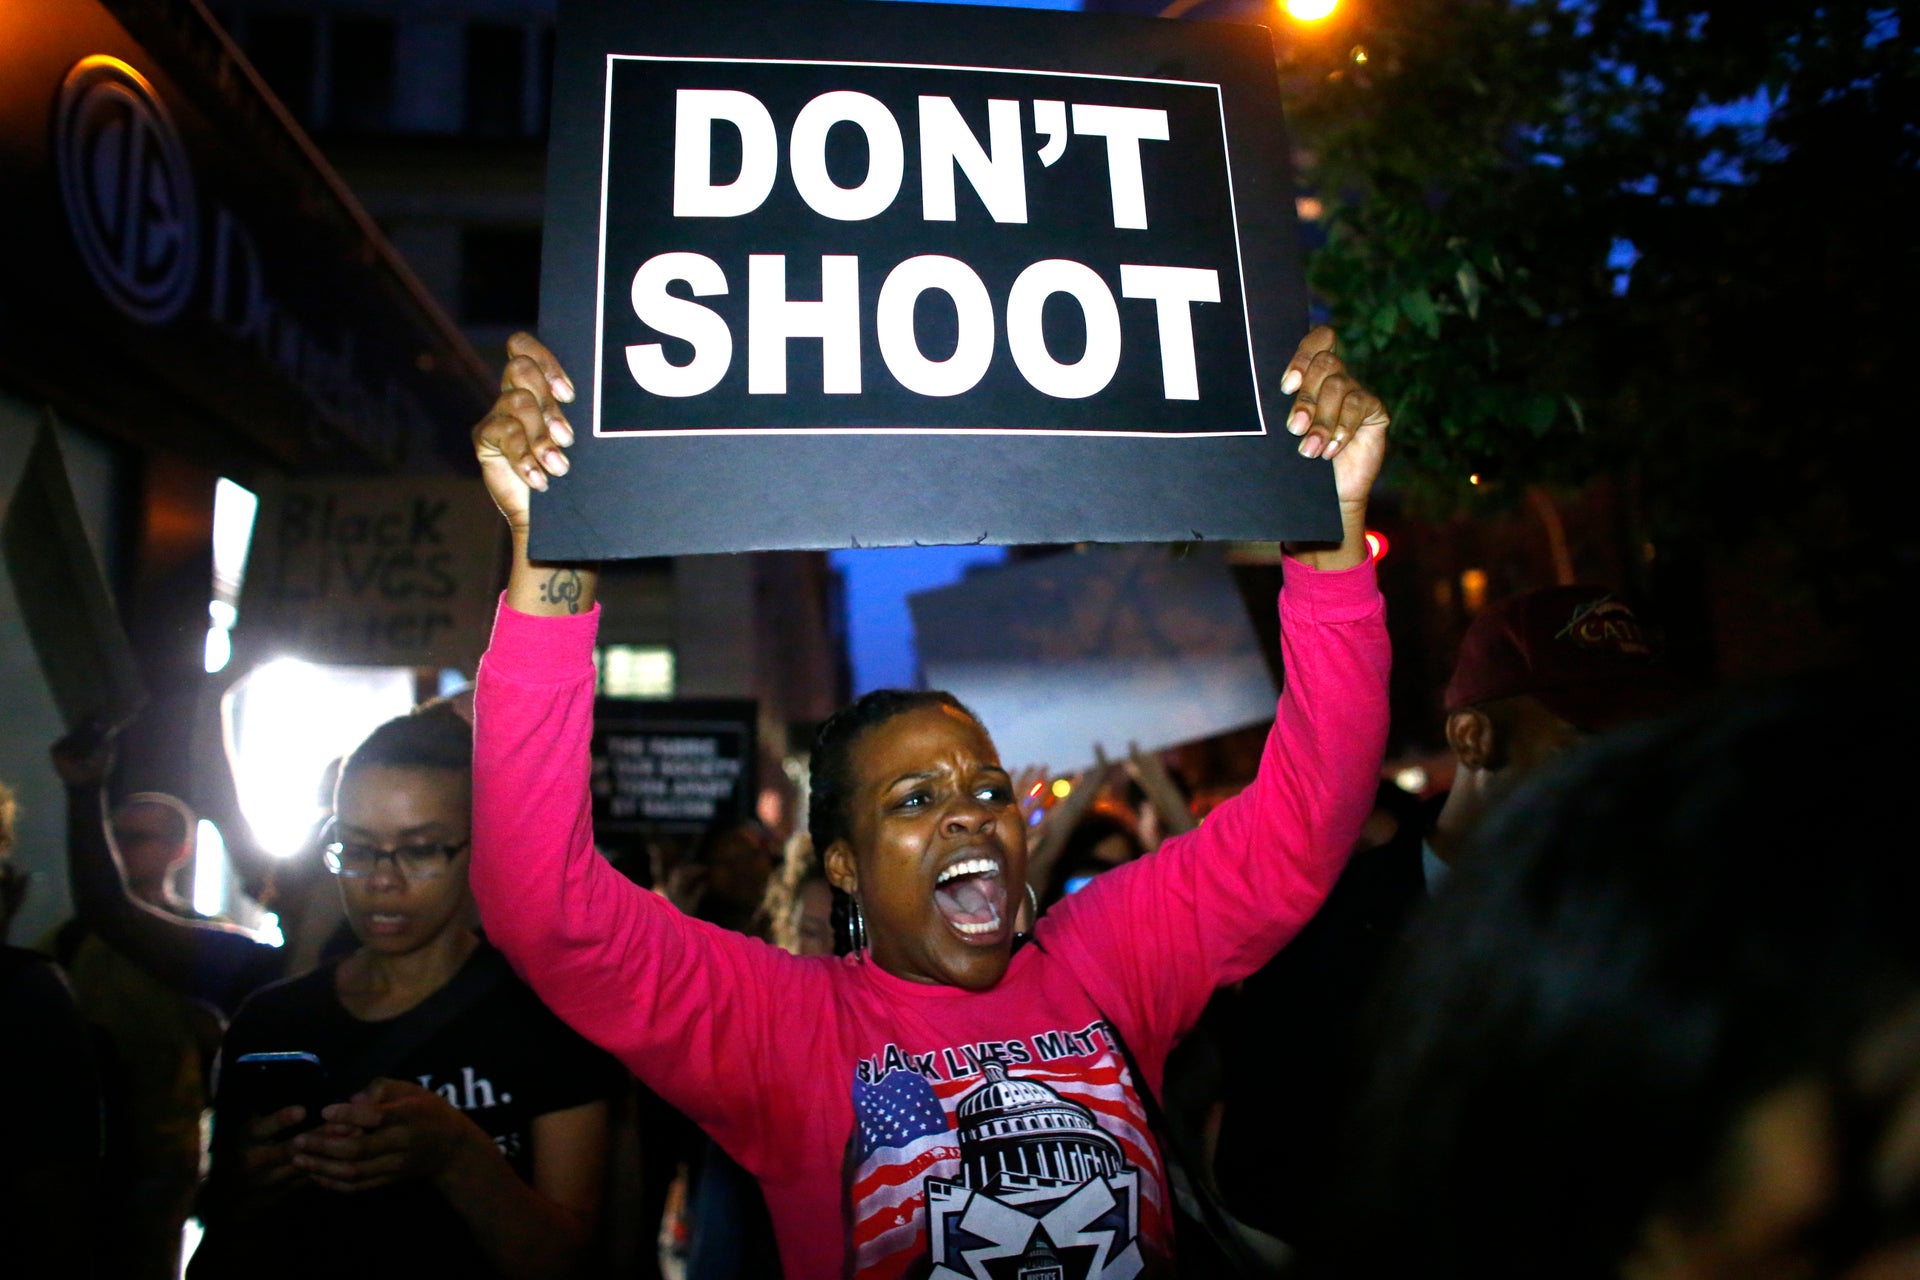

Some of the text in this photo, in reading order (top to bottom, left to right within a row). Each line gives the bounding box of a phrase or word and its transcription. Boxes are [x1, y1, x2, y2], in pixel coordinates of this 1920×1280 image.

[673, 88, 1170, 231] DON'T
[624, 251, 1221, 400] SHOOT
[857, 1043, 942, 1085] BLACK
[943, 1040, 1031, 1080] LIVES
